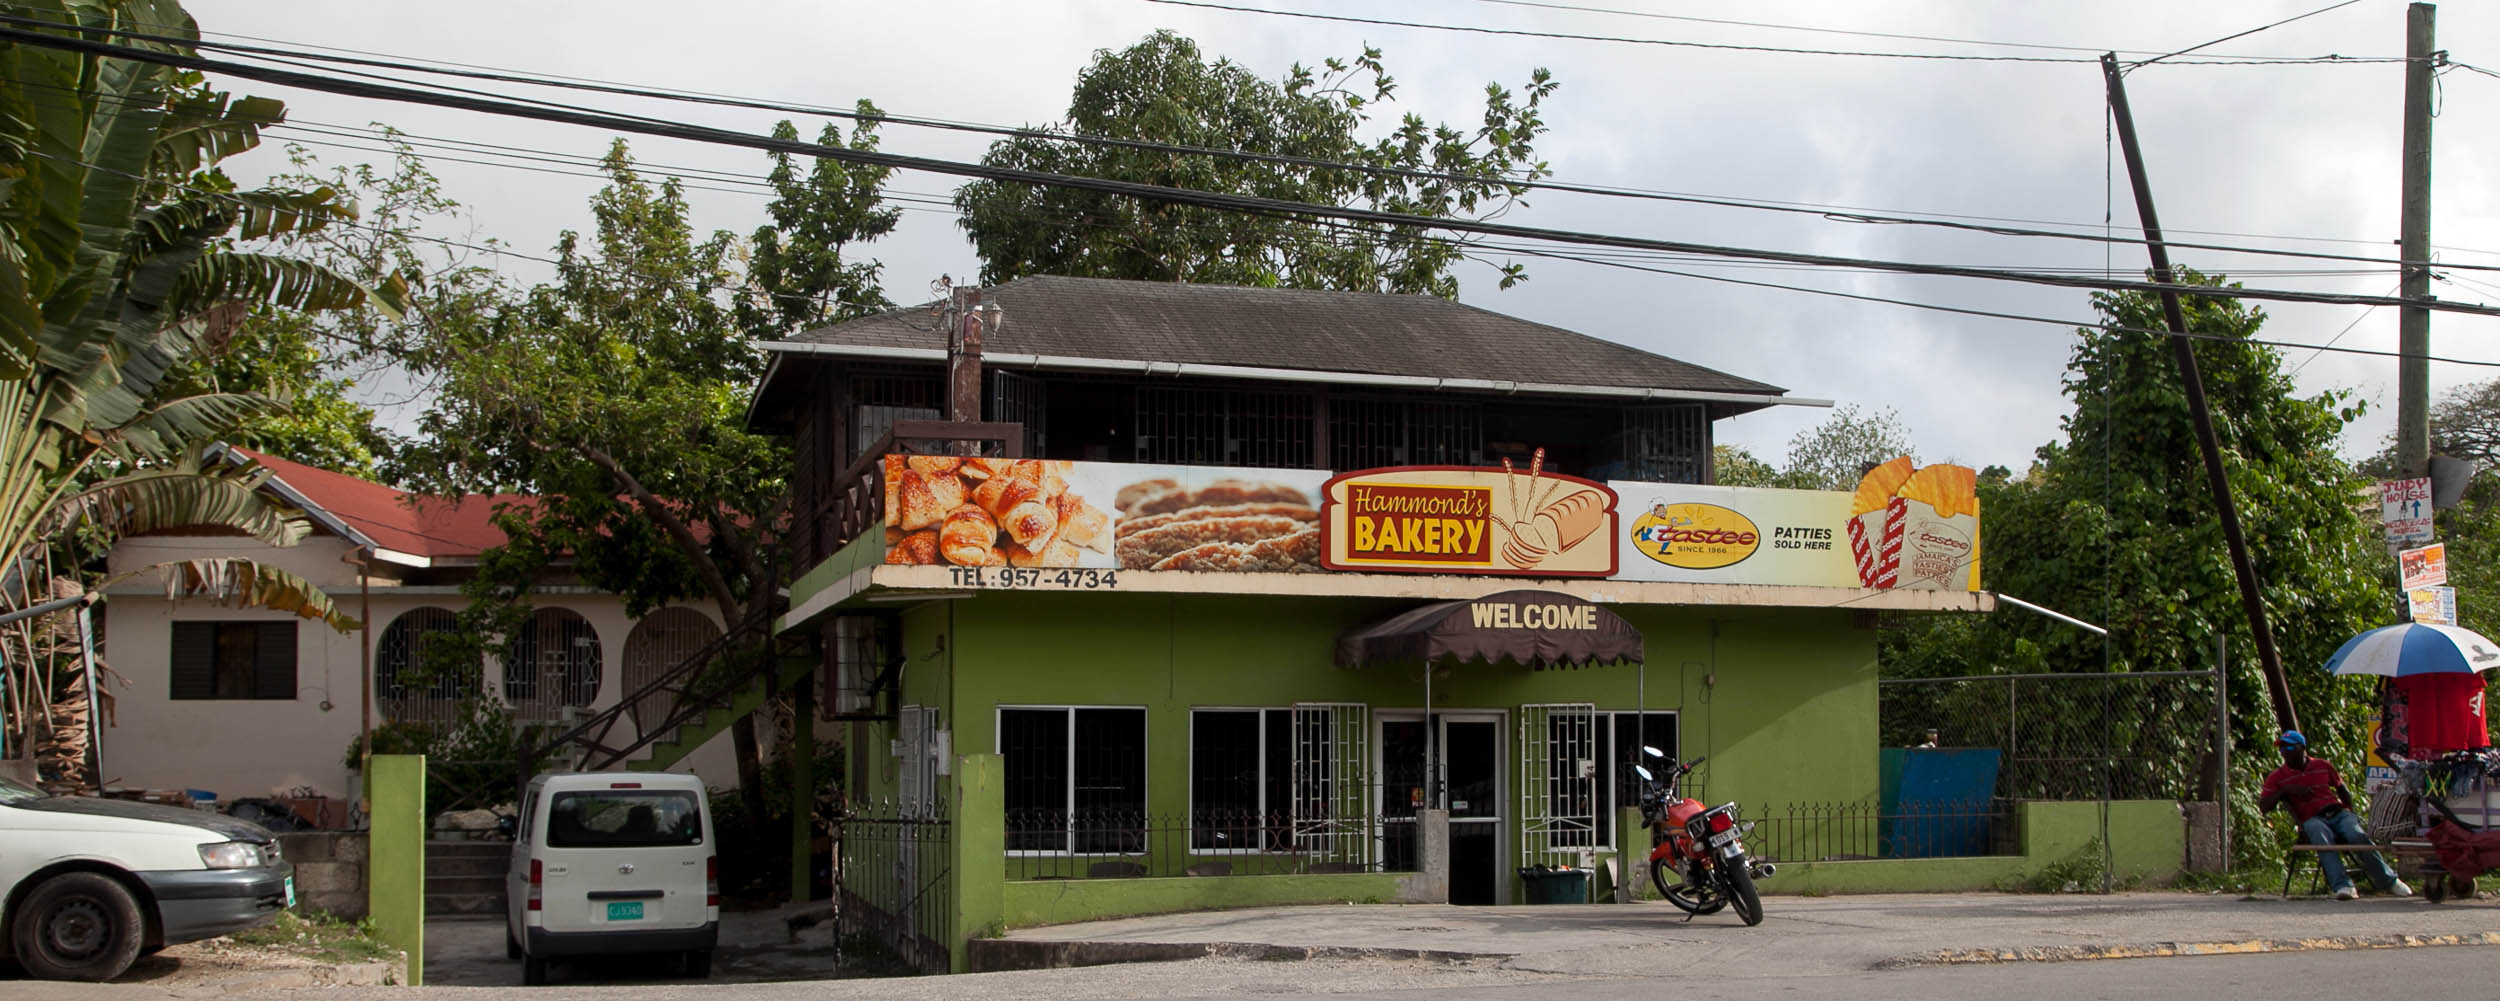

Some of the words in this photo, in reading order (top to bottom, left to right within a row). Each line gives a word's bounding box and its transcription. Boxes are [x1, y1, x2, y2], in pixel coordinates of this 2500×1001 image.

[2384, 477, 2427, 493] JUDY
[1355, 488, 1488, 517] Hammond's
[2386, 490, 2429, 503] HOUSE
[1355, 516, 1486, 554] BAKERY
[1657, 525, 1756, 545] tastee
[1774, 527, 1832, 540] PATTIES
[1920, 533, 1968, 550] tastee
[1708, 546, 1728, 554] 1966
[1774, 539, 1801, 549] SOLD
[1804, 540, 1832, 550] HERE
[1912, 552, 1960, 568] JAMAICA'S
[1471, 603, 1598, 630] WELCOME
